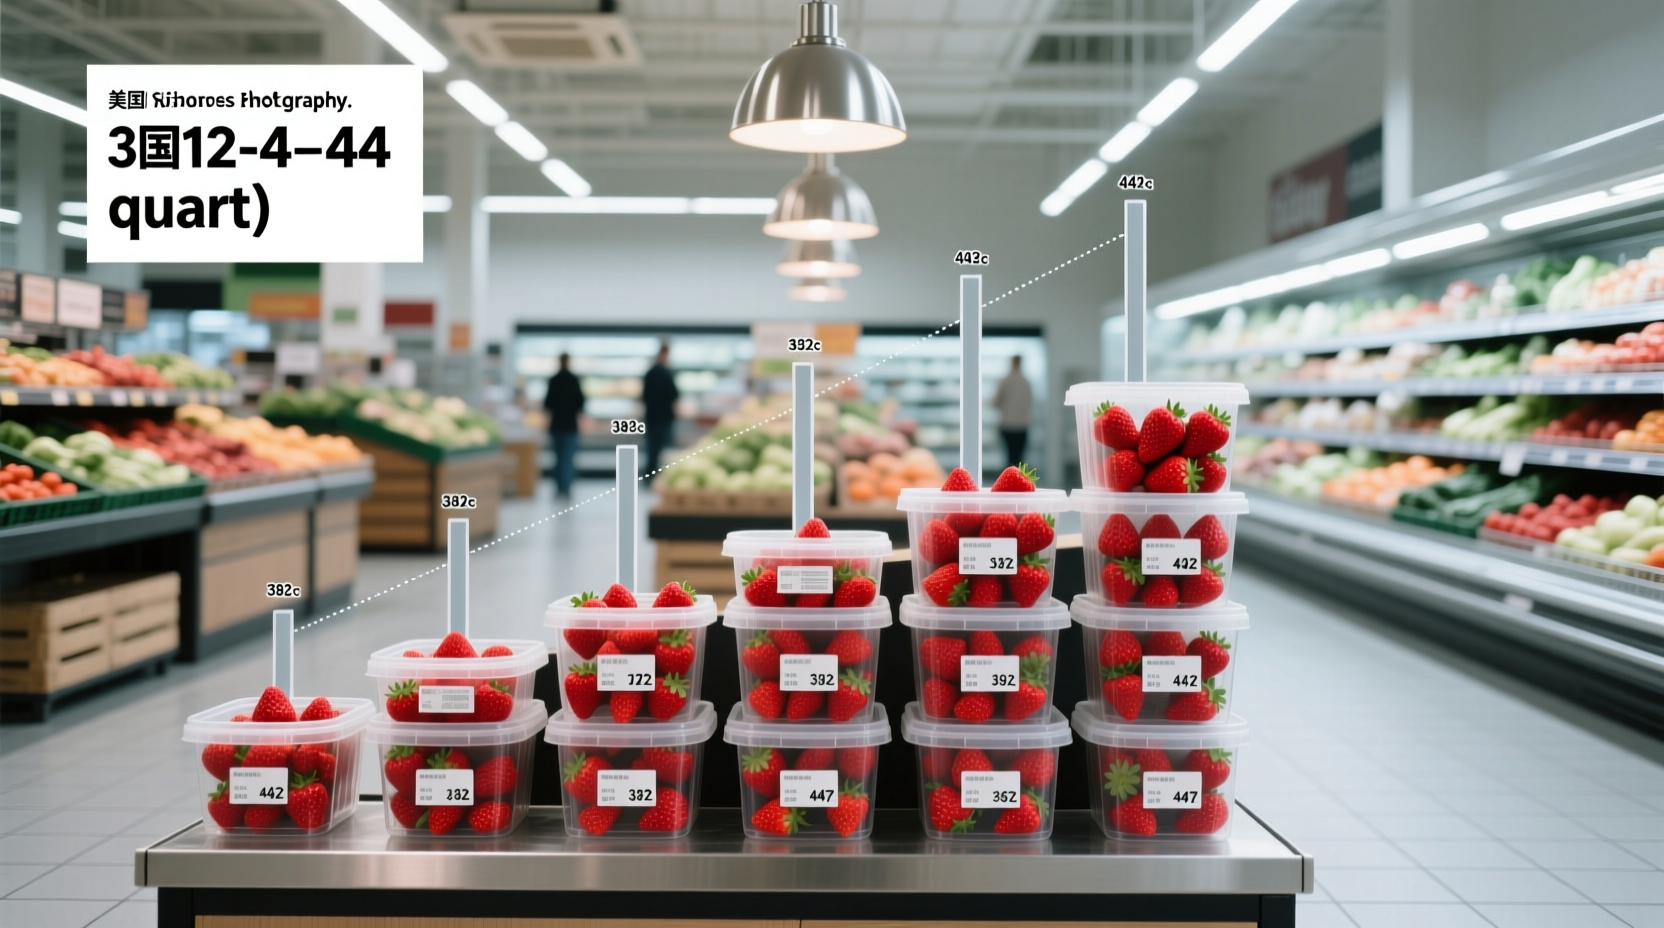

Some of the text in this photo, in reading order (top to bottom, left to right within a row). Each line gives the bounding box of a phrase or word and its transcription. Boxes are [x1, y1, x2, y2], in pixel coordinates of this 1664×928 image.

[992, 675, 1015, 686] 392
[1173, 675, 1197, 686] 442
[260, 787, 283, 799] 442
[810, 790, 834, 802] 447
[1174, 791, 1197, 803] 447
